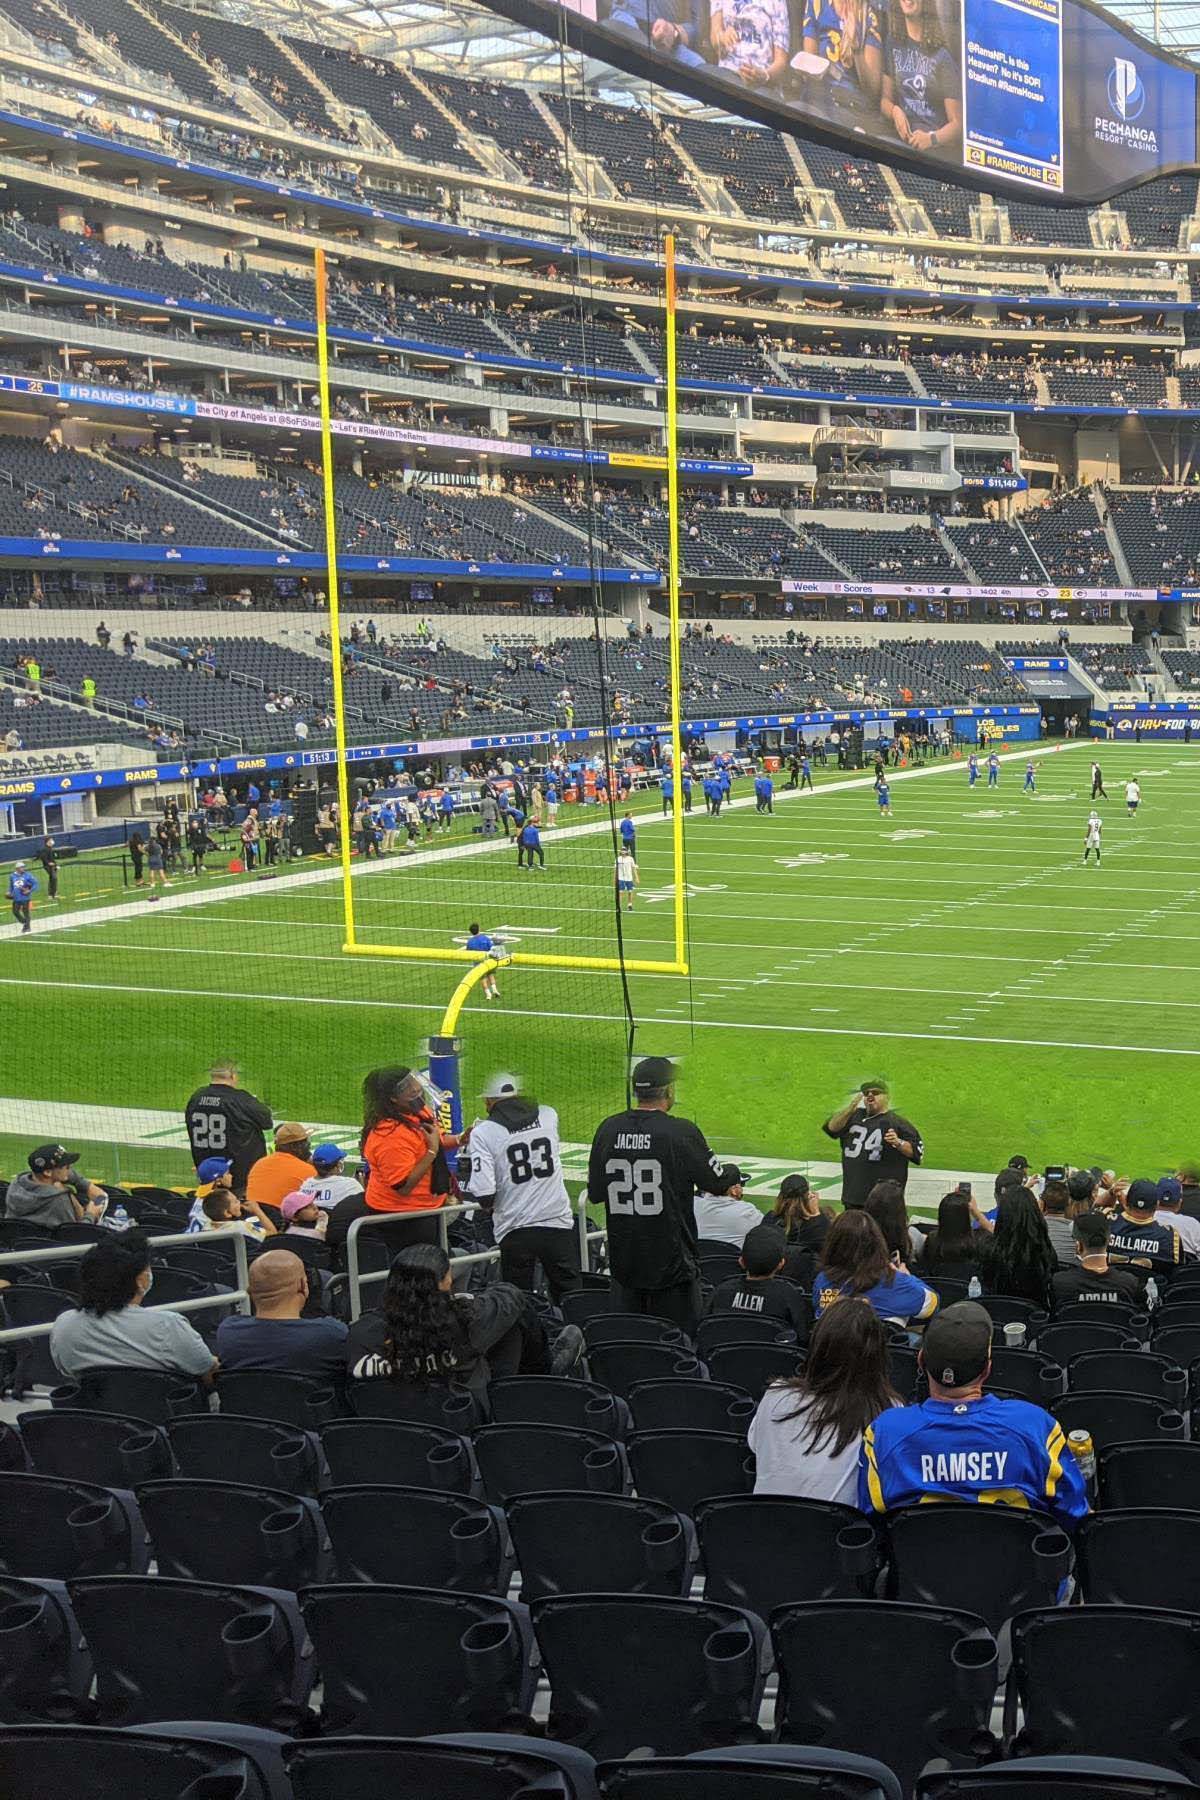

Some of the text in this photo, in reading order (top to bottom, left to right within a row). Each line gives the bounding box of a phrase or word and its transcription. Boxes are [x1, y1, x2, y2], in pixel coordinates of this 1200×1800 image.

[967, 55, 999, 75] Heaven?
[1002, 66, 1012, 79] No
[967, 70, 998, 88] Stadium
[1094, 117, 1157, 144] PECHANGA
[1094, 131, 1125, 147] RESORT
[986, 155, 1042, 179] #RAMSHOUSE
[69, 386, 176, 410] #RAMSHOUSE
[212, 406, 229, 419] City
[230, 408, 239, 417] of
[240, 410, 268, 423] Angels
[268, 415, 277, 423] at
[988, 479, 1018, 488] $11,140
[793, 582, 819, 592] Week
[843, 584, 873, 593] Scores
[236, 758, 267, 770] RAMS
[309, 752, 330, 763] 51:13
[125, 769, 158, 782] RAMS
[0, 782, 36, 795] RAMS
[199, 1096, 221, 1106] JACOBS
[191, 1112, 227, 1150] 28
[614, 1133, 651, 1150] JACOBS
[844, 1124, 884, 1161] 34
[506, 1136, 555, 1185] 83
[605, 1158, 663, 1216] 28
[1108, 1233, 1160, 1254] GALLARZO
[820, 1288, 840, 1296] LOS
[732, 1292, 764, 1313] ALLEN
[921, 1451, 1008, 1483] RAMSEY
